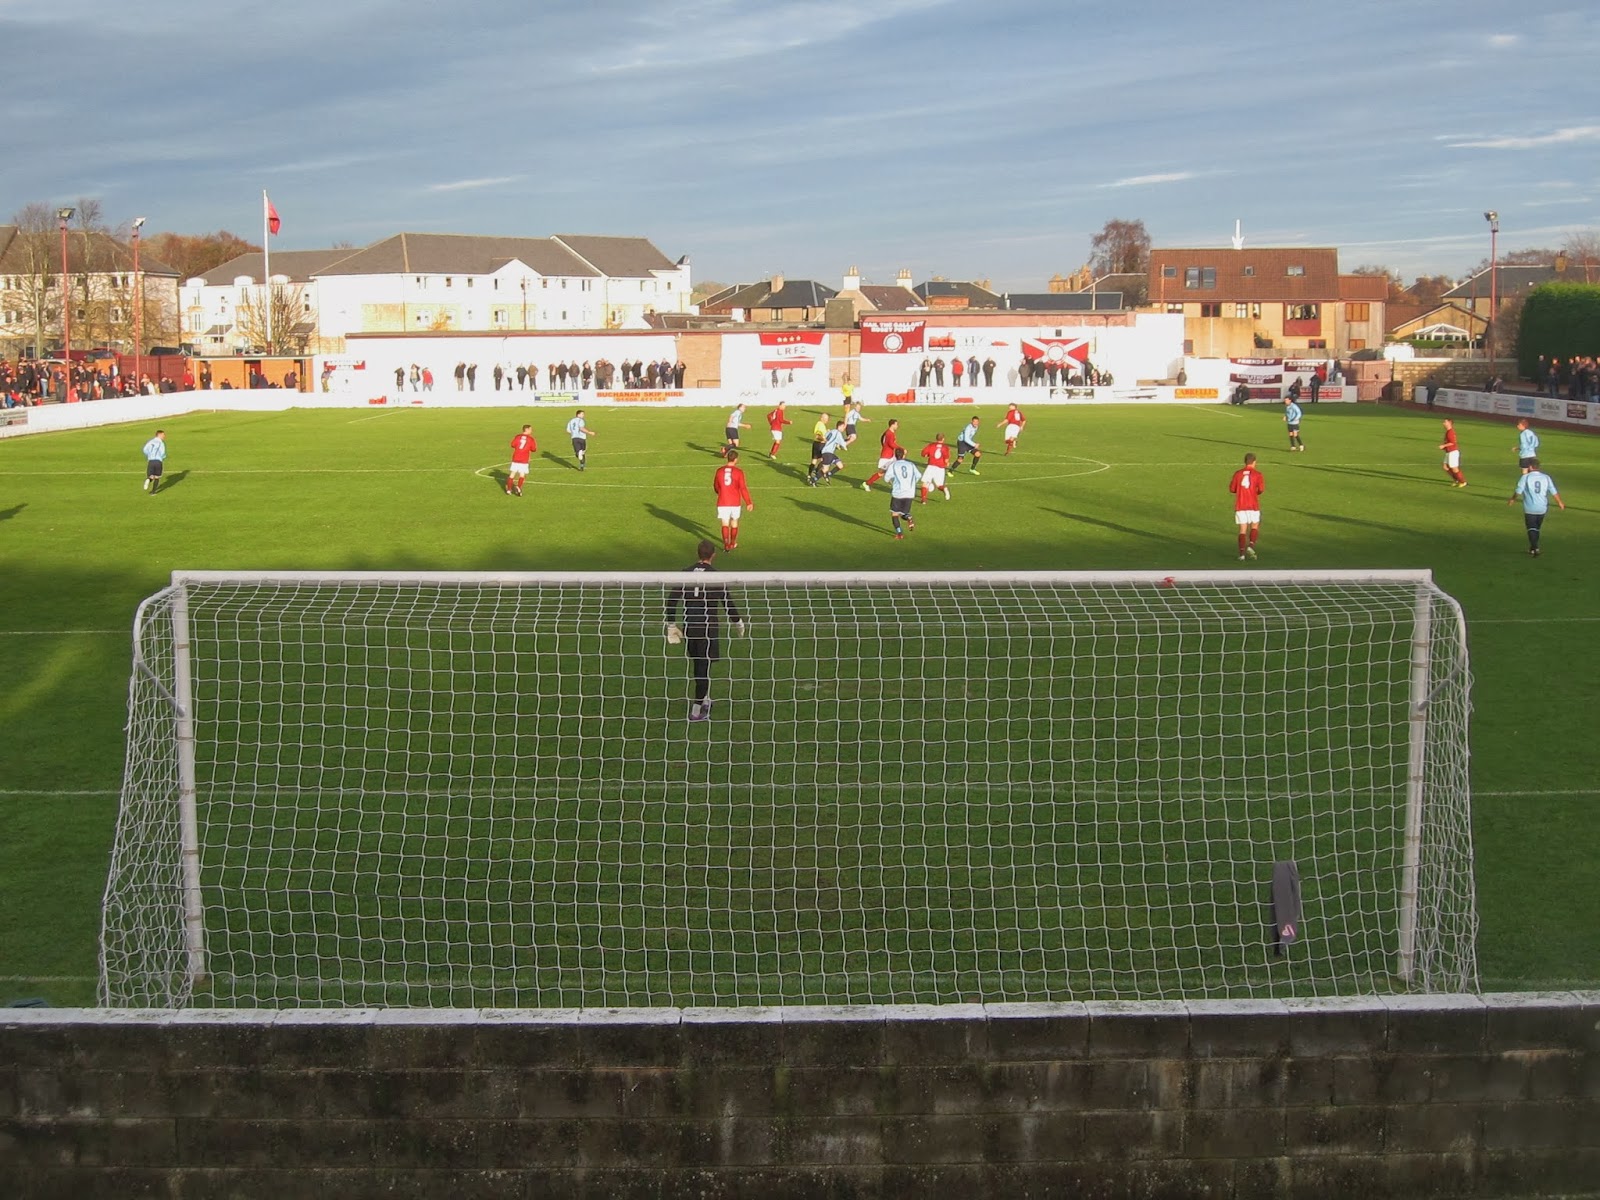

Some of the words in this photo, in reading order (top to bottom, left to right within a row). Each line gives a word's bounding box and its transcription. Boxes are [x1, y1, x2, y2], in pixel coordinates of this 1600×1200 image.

[724, 472, 732, 486] 5
[901, 466, 908, 479] 8
[1241, 475, 1250, 489] 4
[1534, 480, 1542, 494] 9
